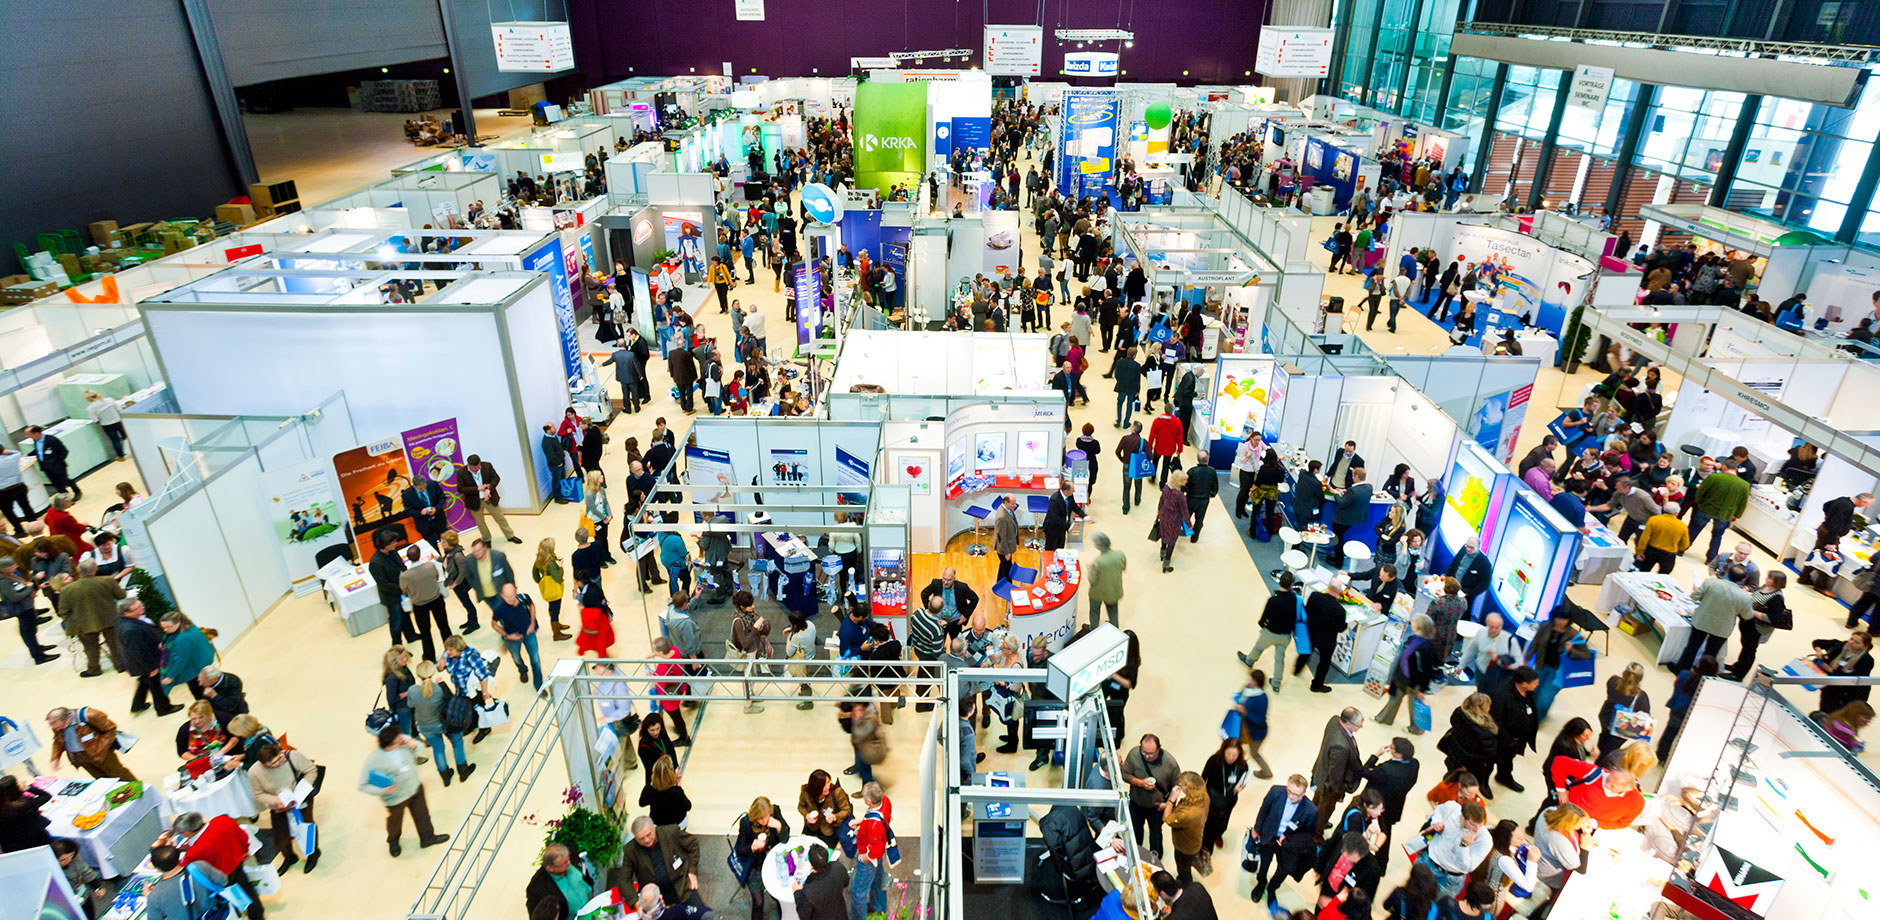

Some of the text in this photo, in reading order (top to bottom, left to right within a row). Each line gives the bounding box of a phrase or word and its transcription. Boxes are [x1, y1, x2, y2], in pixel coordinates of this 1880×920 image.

[1578, 80, 1605, 89] VORTRÄGE
[1574, 91, 1600, 102] SEMINARE
[881, 136, 917, 149] KRKA
[1486, 239, 1532, 260] Tasectan
[1737, 391, 1770, 411] KHRESMOI
[370, 441, 394, 453] FEIBA
[1095, 649, 1125, 677] MSD
